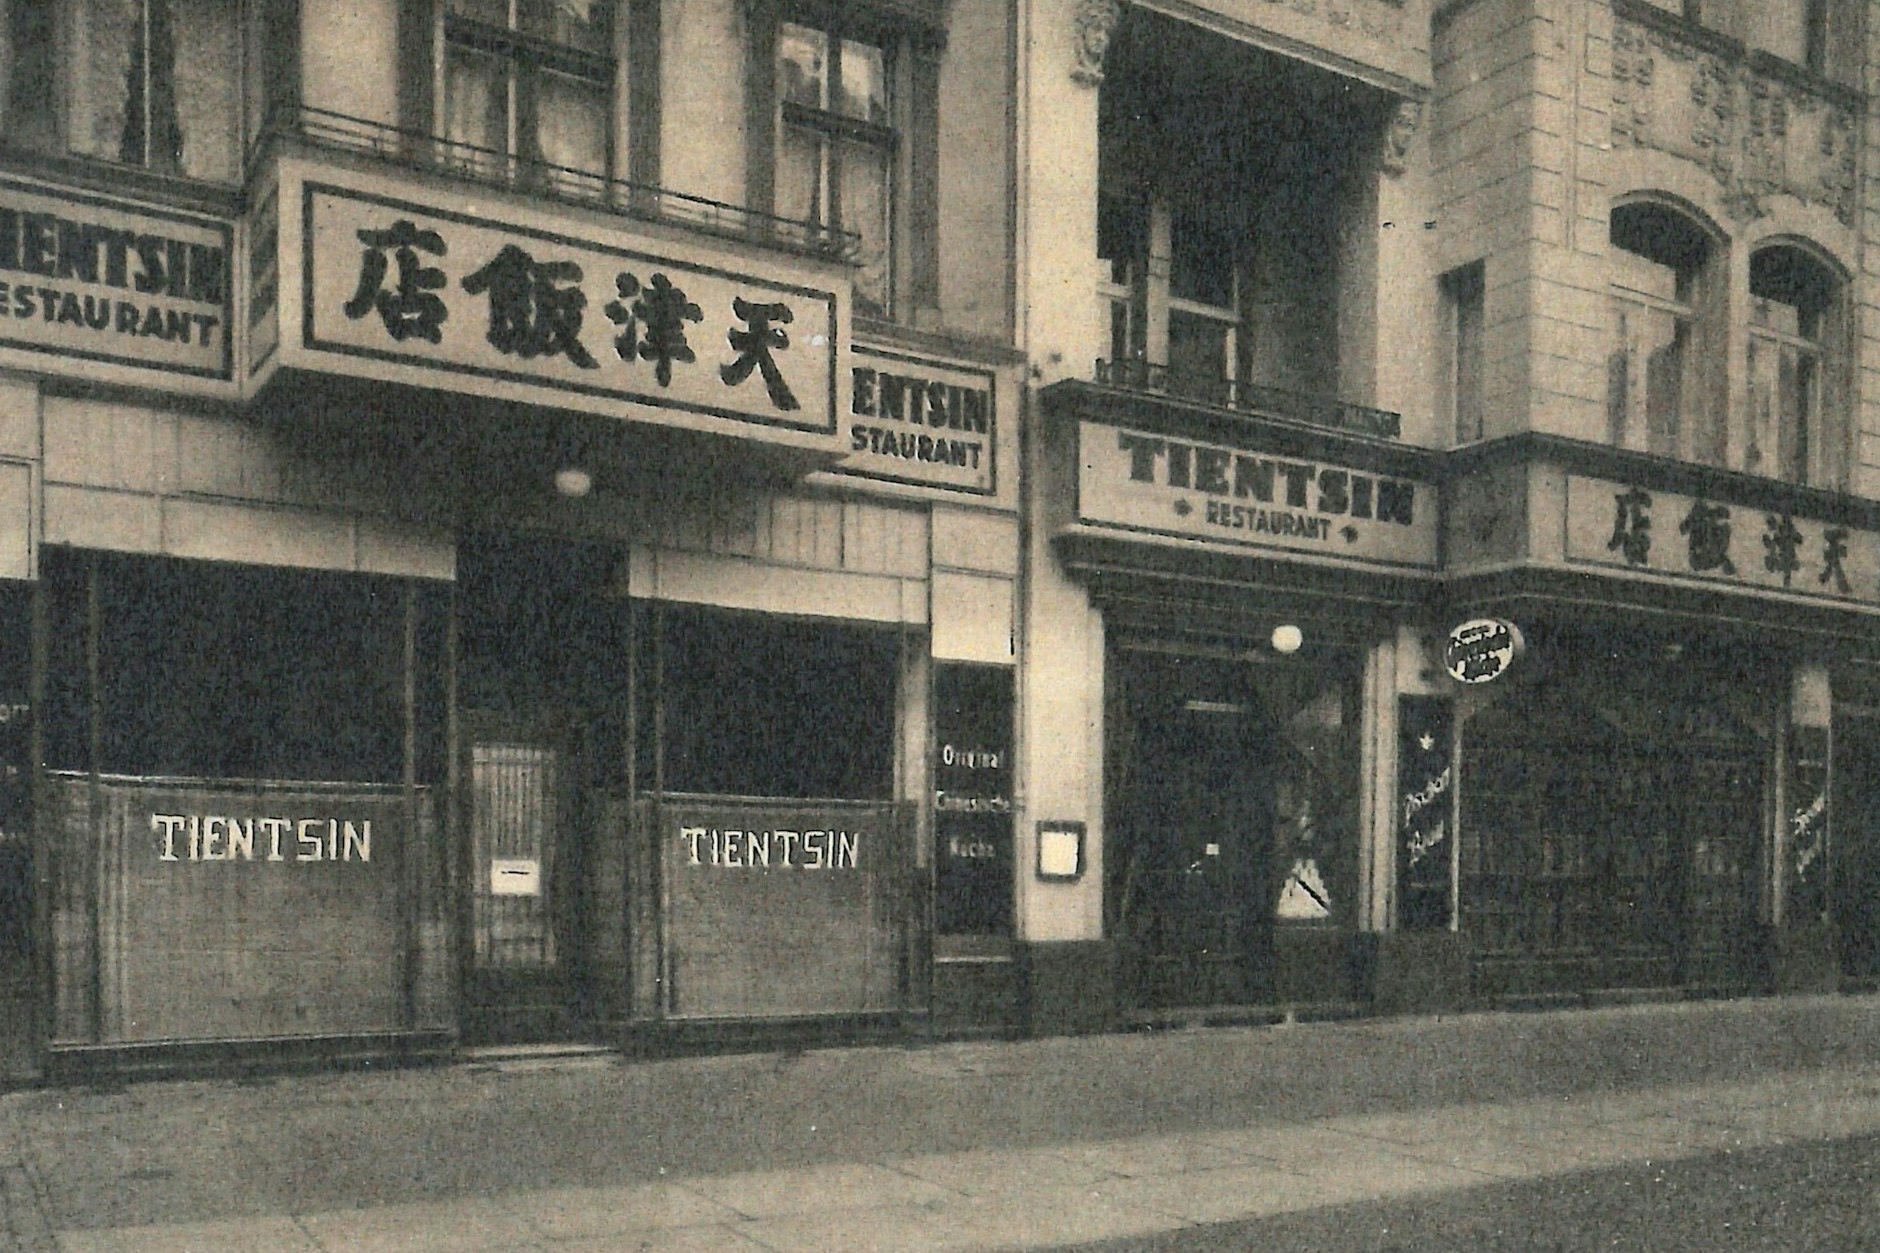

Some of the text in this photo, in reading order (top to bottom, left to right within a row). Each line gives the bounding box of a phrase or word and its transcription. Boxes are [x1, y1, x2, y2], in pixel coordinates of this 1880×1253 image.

[851, 367, 989, 434] ENTSIN
[851, 423, 983, 469] STAURANT
[1117, 430, 1415, 526] TIENTSIN
[1205, 499, 1332, 541] RESTAURANT
[151, 813, 371, 863] TIENTSIN
[680, 827, 860, 870] TIENTSIN
